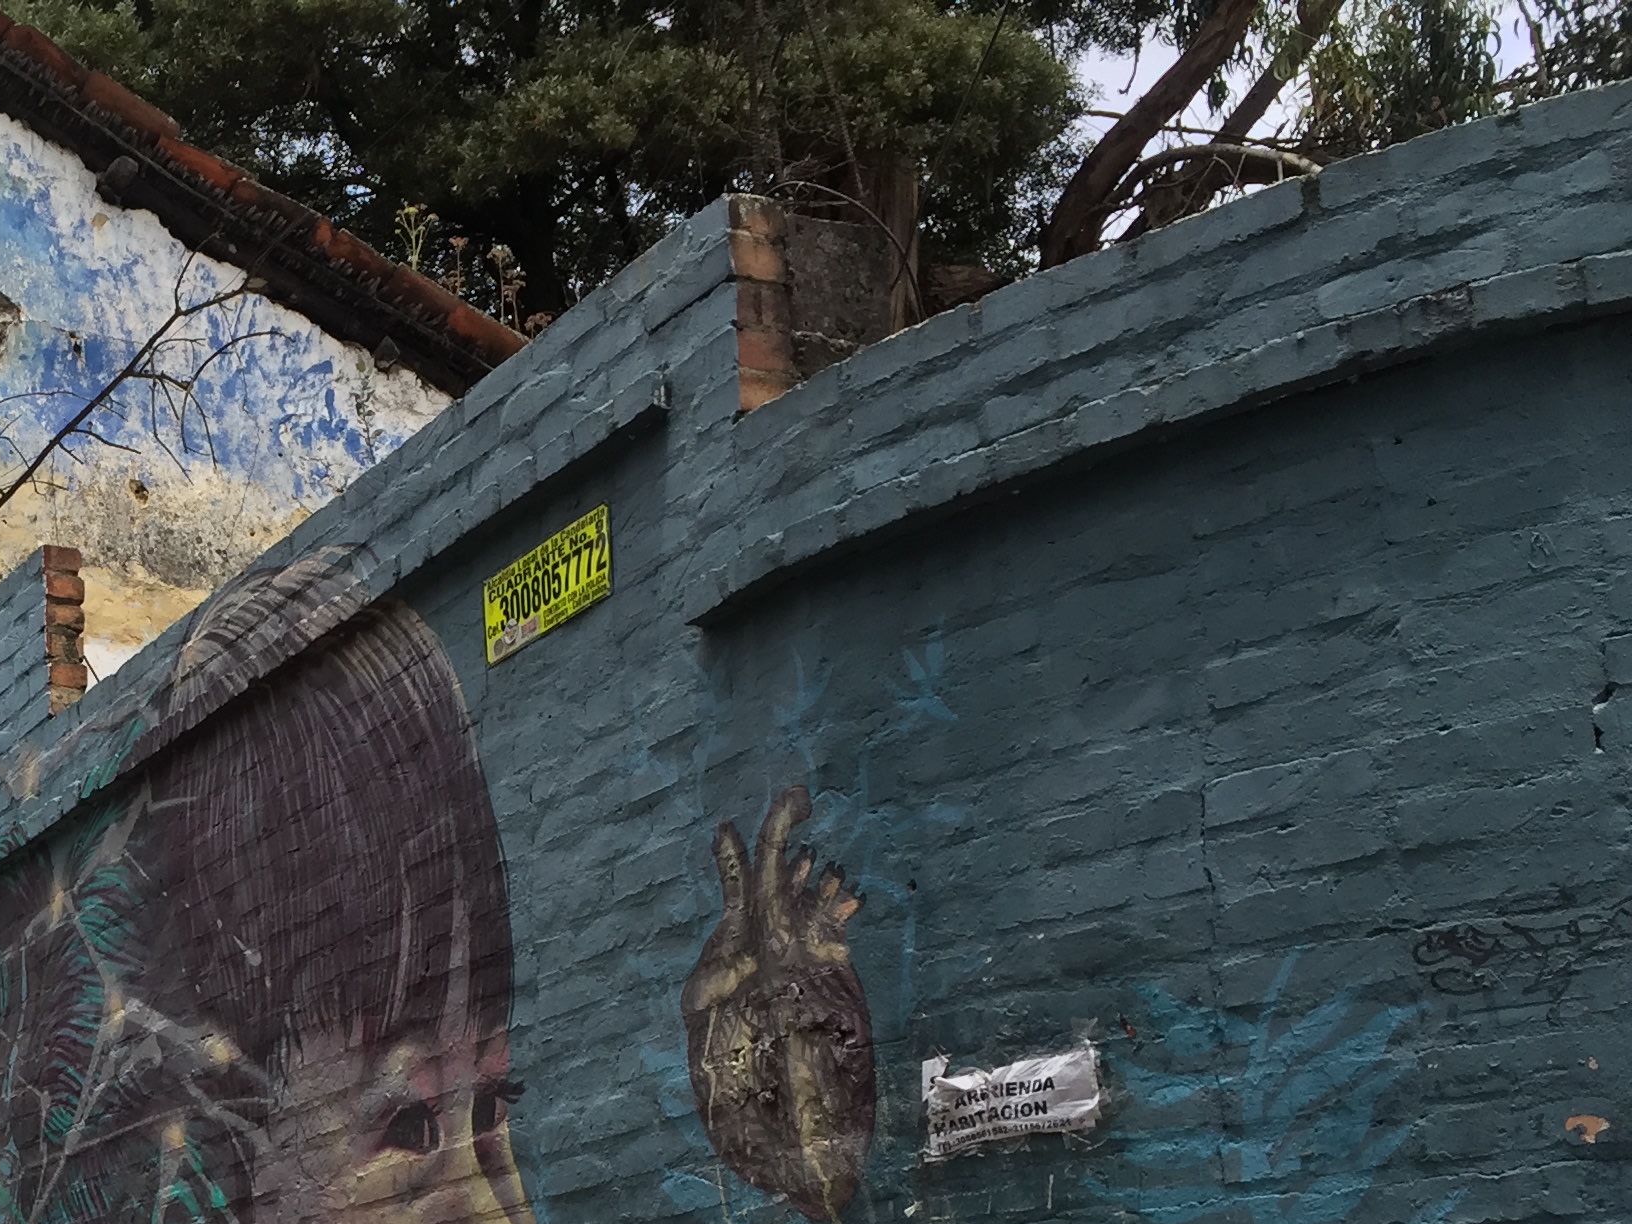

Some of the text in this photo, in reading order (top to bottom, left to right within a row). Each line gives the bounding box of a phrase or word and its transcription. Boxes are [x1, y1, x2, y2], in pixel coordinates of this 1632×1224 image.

[560, 507, 605, 542] Candelaria
[489, 543, 566, 603] CUADRANTE
[569, 532, 591, 550] No.
[499, 532, 607, 632] 3008057772
[954, 1076, 1055, 1110] ARRIENDA
